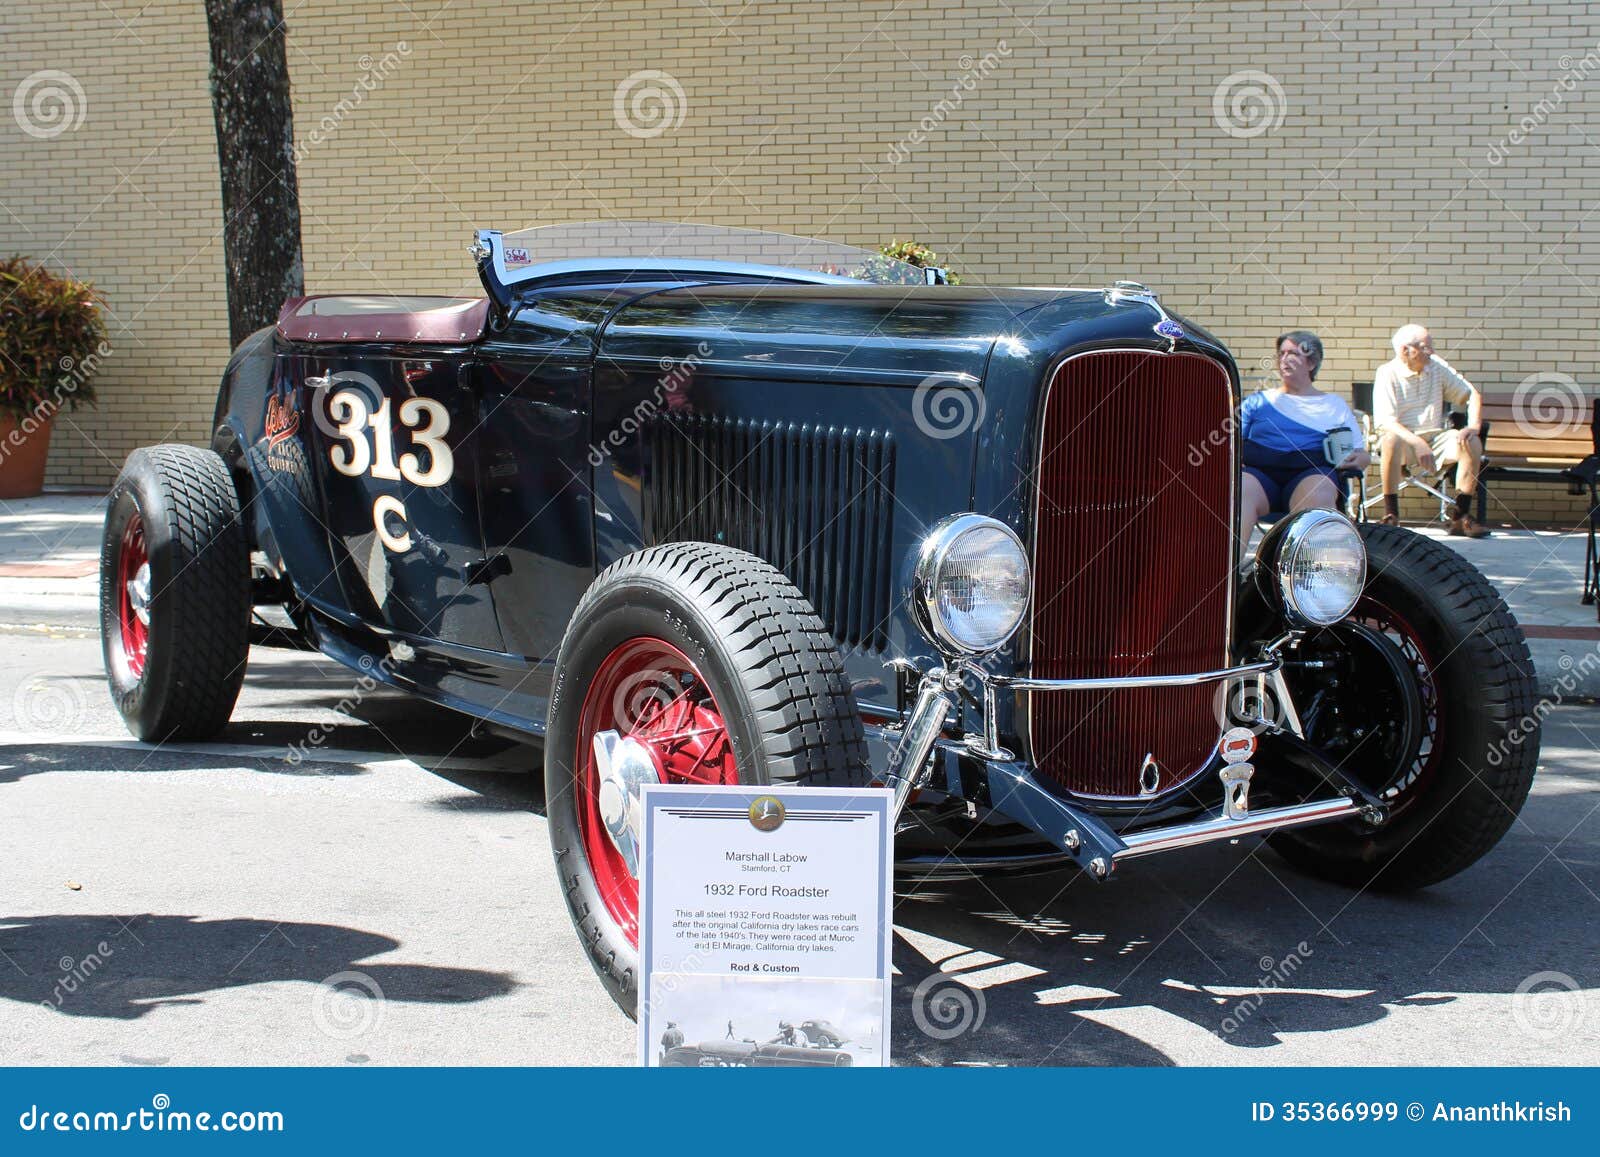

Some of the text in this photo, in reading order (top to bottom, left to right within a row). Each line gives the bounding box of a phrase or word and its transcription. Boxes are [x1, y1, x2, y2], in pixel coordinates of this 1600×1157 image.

[330, 392, 454, 487] 313
[374, 495, 412, 553] C
[725, 852, 808, 863] Marshall Labow
[779, 865, 792, 873] CT
[703, 884, 830, 898] 1932 Ford Roadster
[675, 910, 693, 918] This
[695, 910, 704, 918] all
[706, 910, 726, 918] steel
[729, 911, 749, 919] 1932
[773, 912, 810, 920] Roadster
[831, 913, 857, 921] rebuilt
[693, 921, 706, 929] the
[708, 921, 738, 931] original
[740, 922, 779, 930] California
[781, 923, 795, 932] dry
[797, 923, 818, 931] lakes
[676, 931, 685, 939] of
[687, 931, 699, 939] the
[701, 931, 717, 939] late
[749, 932, 769, 942] They
[818, 934, 827, 942] at
[829, 934, 855, 942] Muroc
[694, 942, 710, 950] and
[712, 942, 721, 950] El
[756, 943, 795, 951] California
[797, 943, 810, 953] dry
[730, 963, 800, 972] Rod & Custom
